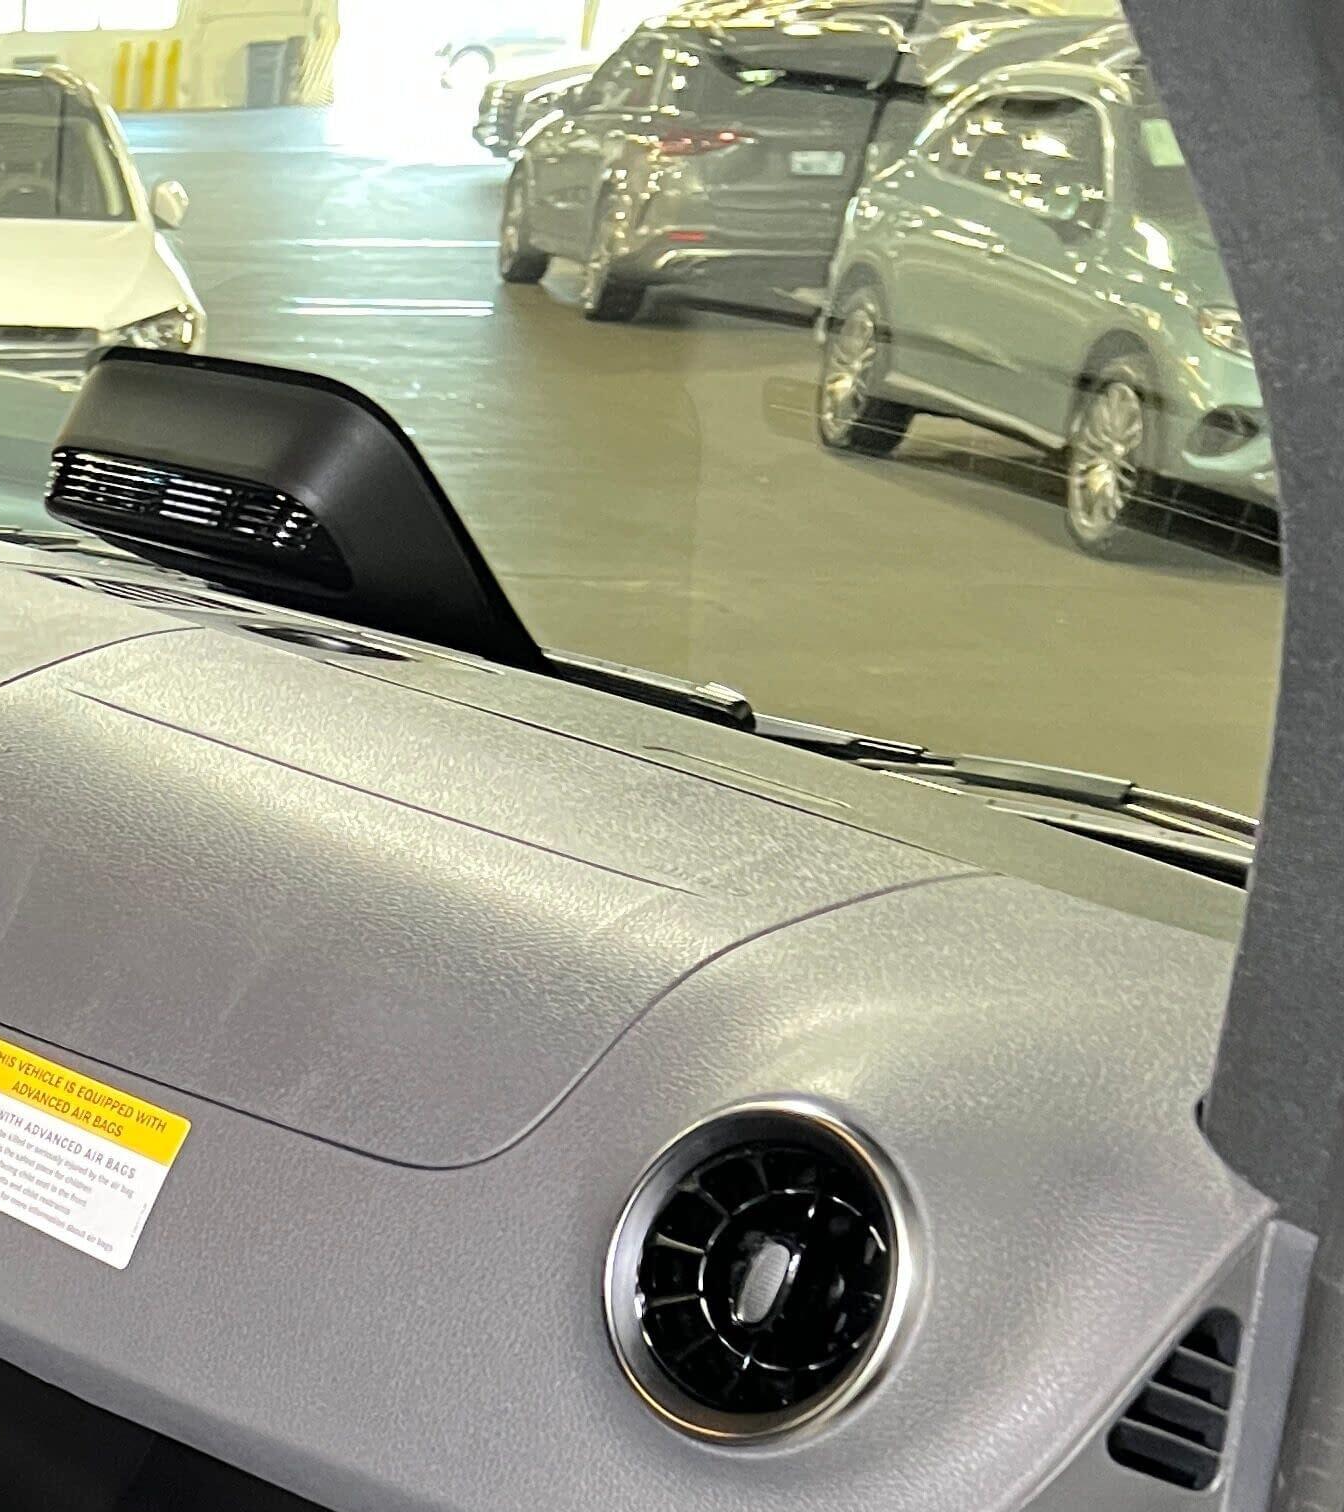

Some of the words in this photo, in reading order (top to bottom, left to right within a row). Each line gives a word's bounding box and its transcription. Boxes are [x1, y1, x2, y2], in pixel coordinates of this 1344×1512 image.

[11, 1081, 70, 1113] ADVANCED
[71, 1106, 90, 1122] AIR
[92, 1115, 123, 1136] BAGS
[17, 1060, 62, 1087] VEHICLE
[63, 1080, 77, 1093] IS
[77, 1085, 134, 1117] EQUIPPED
[135, 1109, 167, 1131] WITH
[0, 1129, 8, 1138] be
[87, 1170, 98, 1182] by
[98, 1174, 109, 1185] the
[120, 1185, 135, 1199] bag
[4, 1147, 16, 1157] the
[54, 1170, 65, 1180] for
[65, 1175, 92, 1192] children
[24, 1121, 82, 1154] ADVANCED
[84, 1148, 103, 1163] AIR
[105, 1157, 136, 1179] BAGS
[0, 1191, 11, 1201] for
[9, 1181, 22, 1191] and
[22, 1188, 39, 1200] child
[19, 1170, 35, 1182] child
[58, 1189, 69, 1198] the
